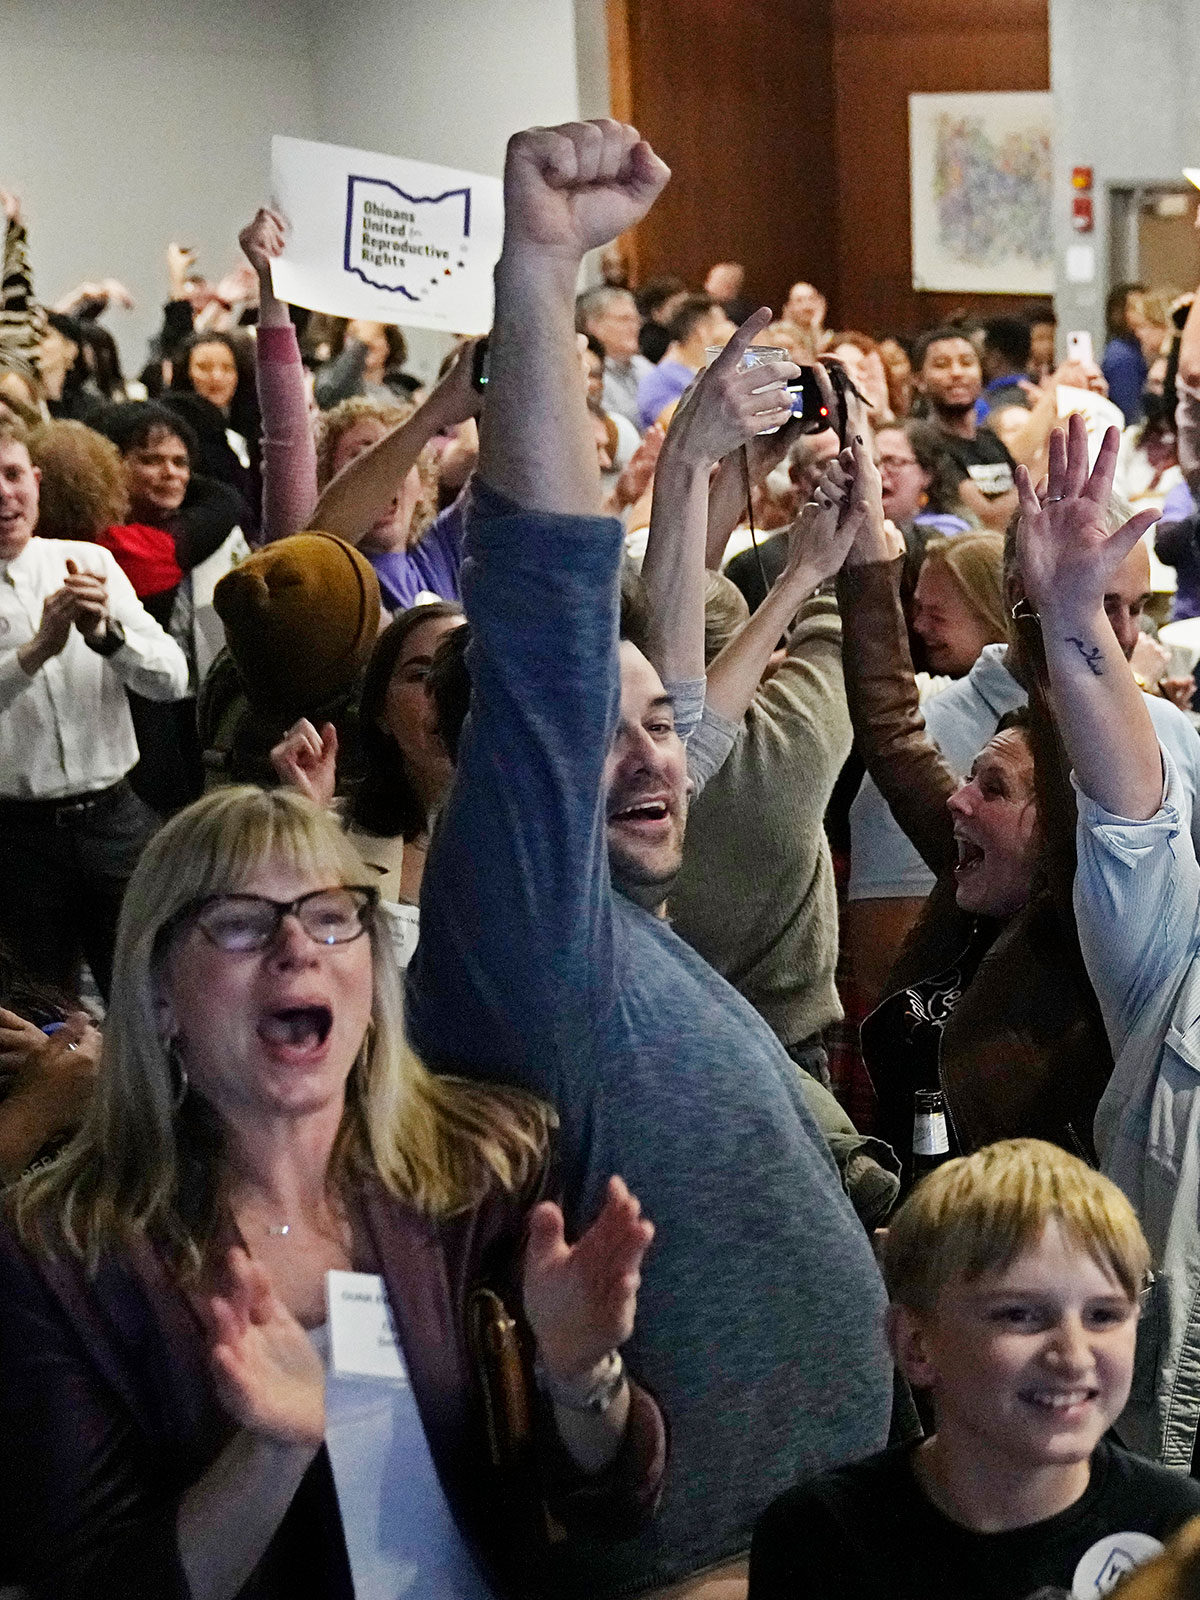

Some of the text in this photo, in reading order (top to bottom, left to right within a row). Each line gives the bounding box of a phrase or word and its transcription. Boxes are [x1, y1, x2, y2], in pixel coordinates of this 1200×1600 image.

[363, 200, 415, 223] Ohioans
[362, 217, 406, 237] United
[361, 232, 450, 261] Reproductive
[361, 249, 406, 268] Rights
